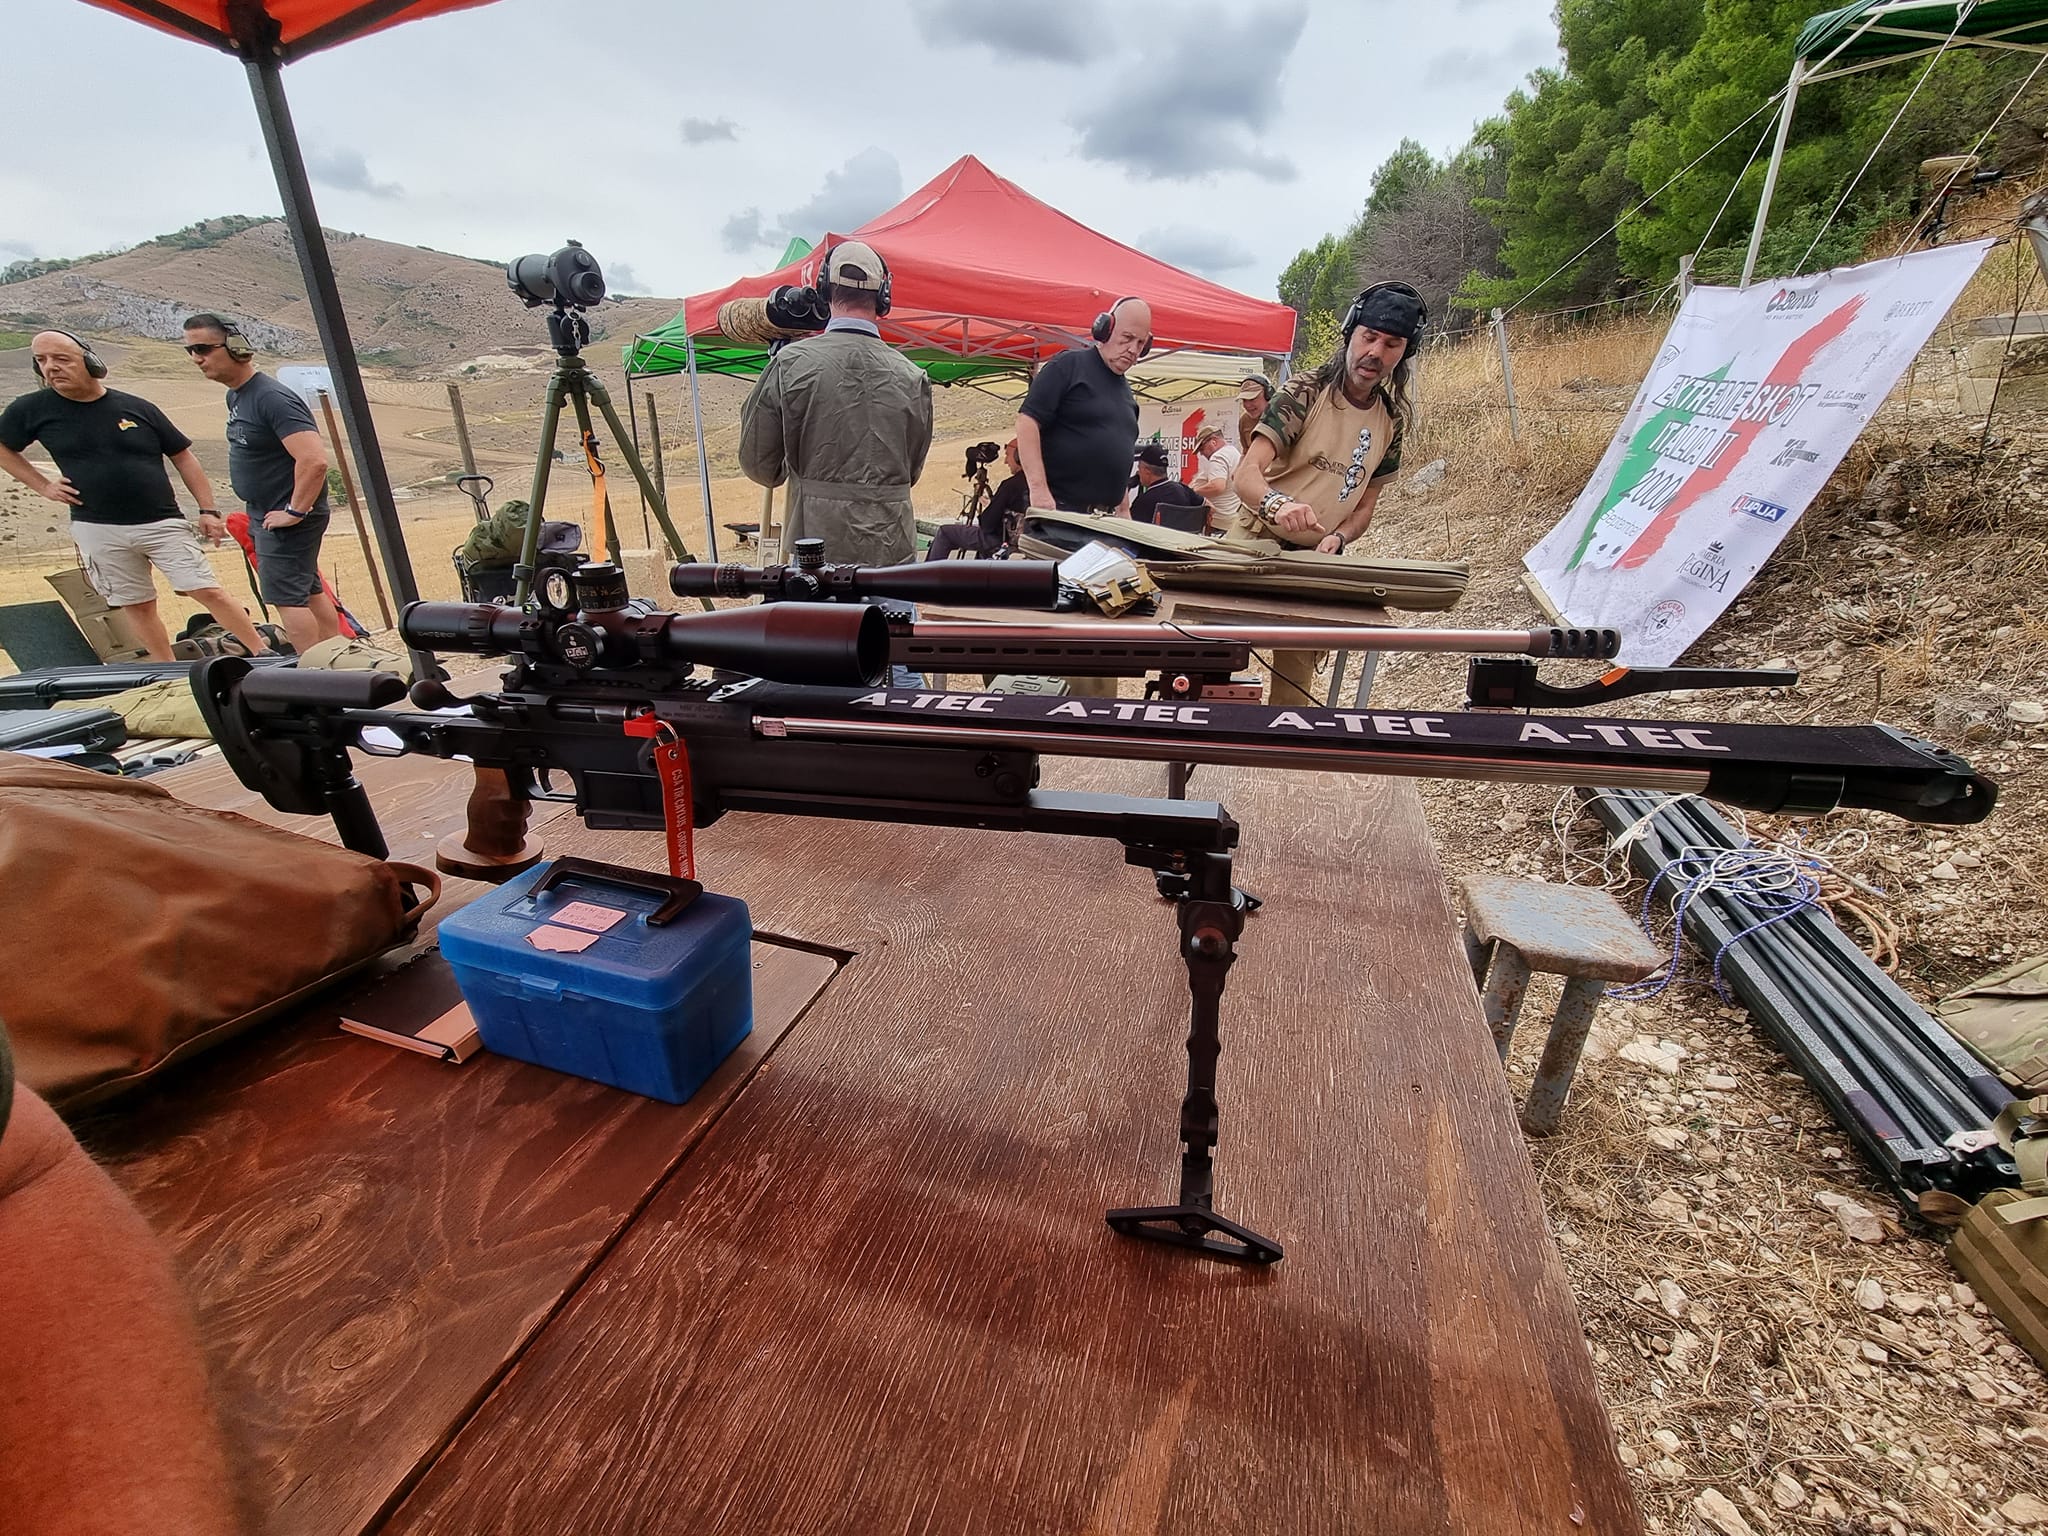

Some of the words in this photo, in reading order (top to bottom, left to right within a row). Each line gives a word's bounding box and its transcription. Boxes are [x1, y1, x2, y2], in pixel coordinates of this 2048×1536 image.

[1652, 375, 1758, 420] EXTREME
[1740, 384, 1822, 428] SHOT
[1648, 420, 1718, 465] ITALIA
[1699, 431, 1740, 470] II
[848, 692, 1003, 713] A-TEC
[1046, 701, 1211, 725] A-TEC
[1267, 711, 1452, 738] A-TEC
[1519, 722, 1731, 752] A-TEC
